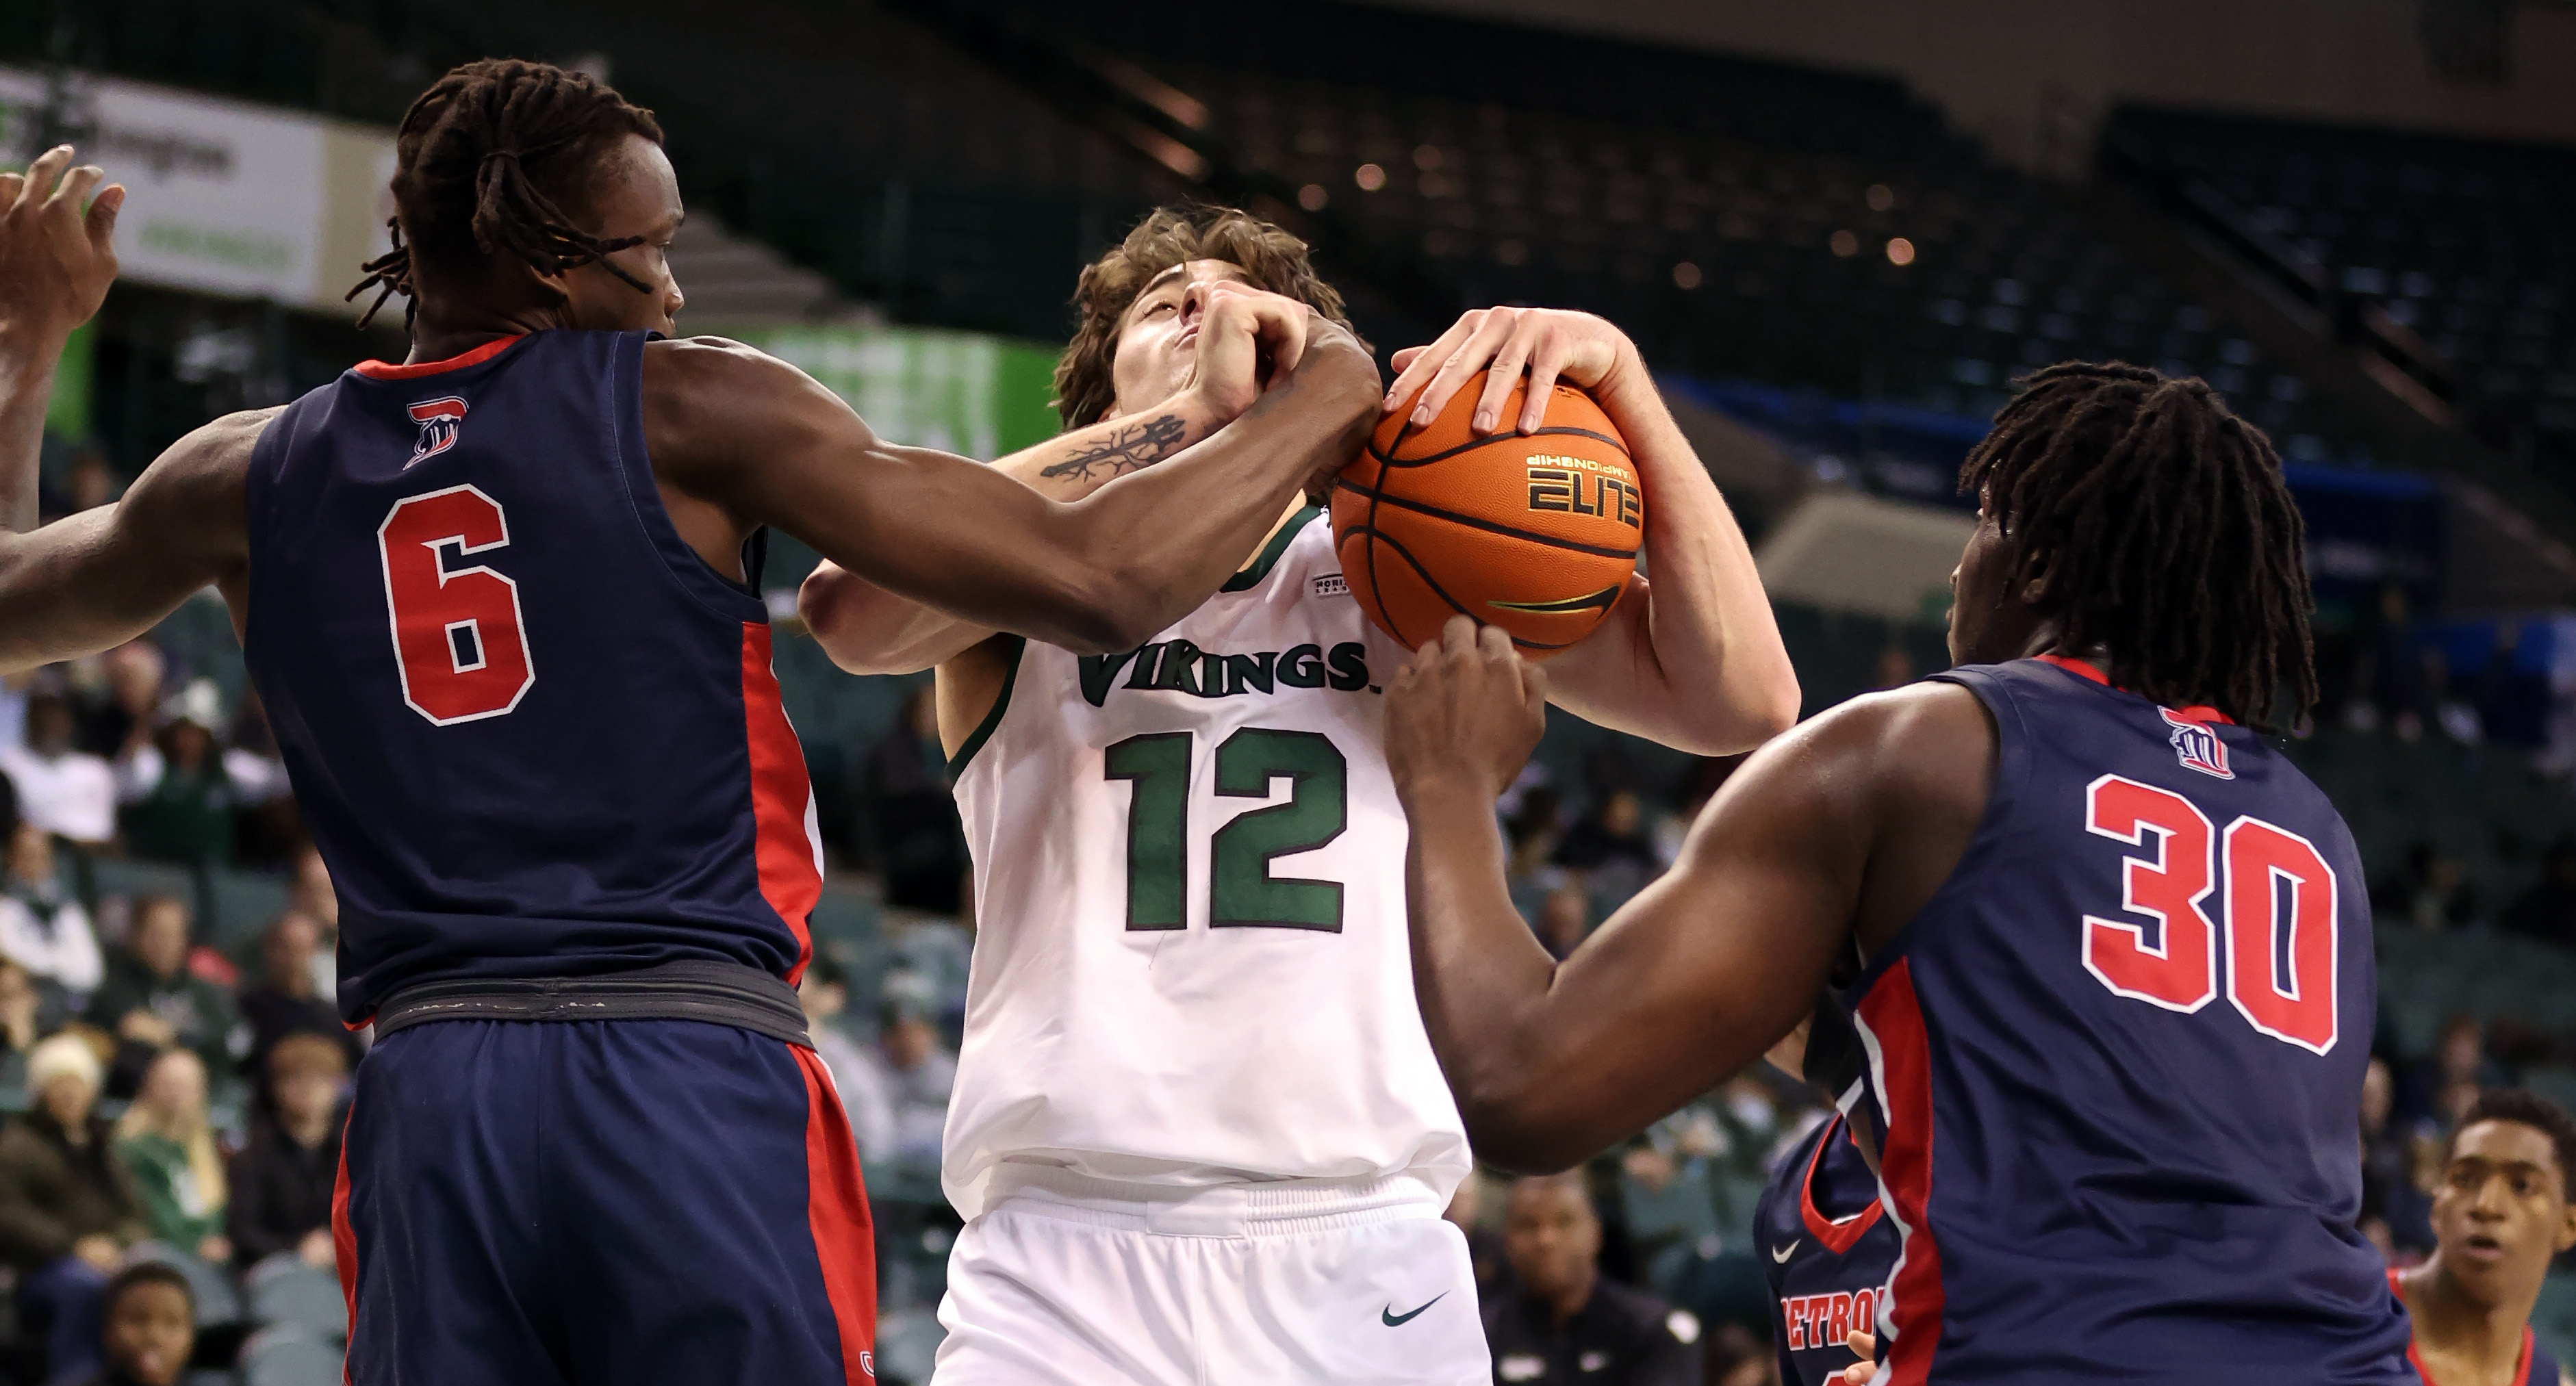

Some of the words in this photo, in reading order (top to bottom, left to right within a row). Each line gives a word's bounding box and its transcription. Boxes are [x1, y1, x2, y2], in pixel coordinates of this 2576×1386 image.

[1527, 454, 1632, 481] AMPIONSHIP
[1527, 467, 1640, 530] ELITE
[377, 483, 535, 727] 6
[1077, 639, 1370, 708] VIKINGS
[1104, 726, 1347, 934] 12
[2081, 773, 2338, 1057] 30
[1781, 1286, 1885, 1352] ETRO
